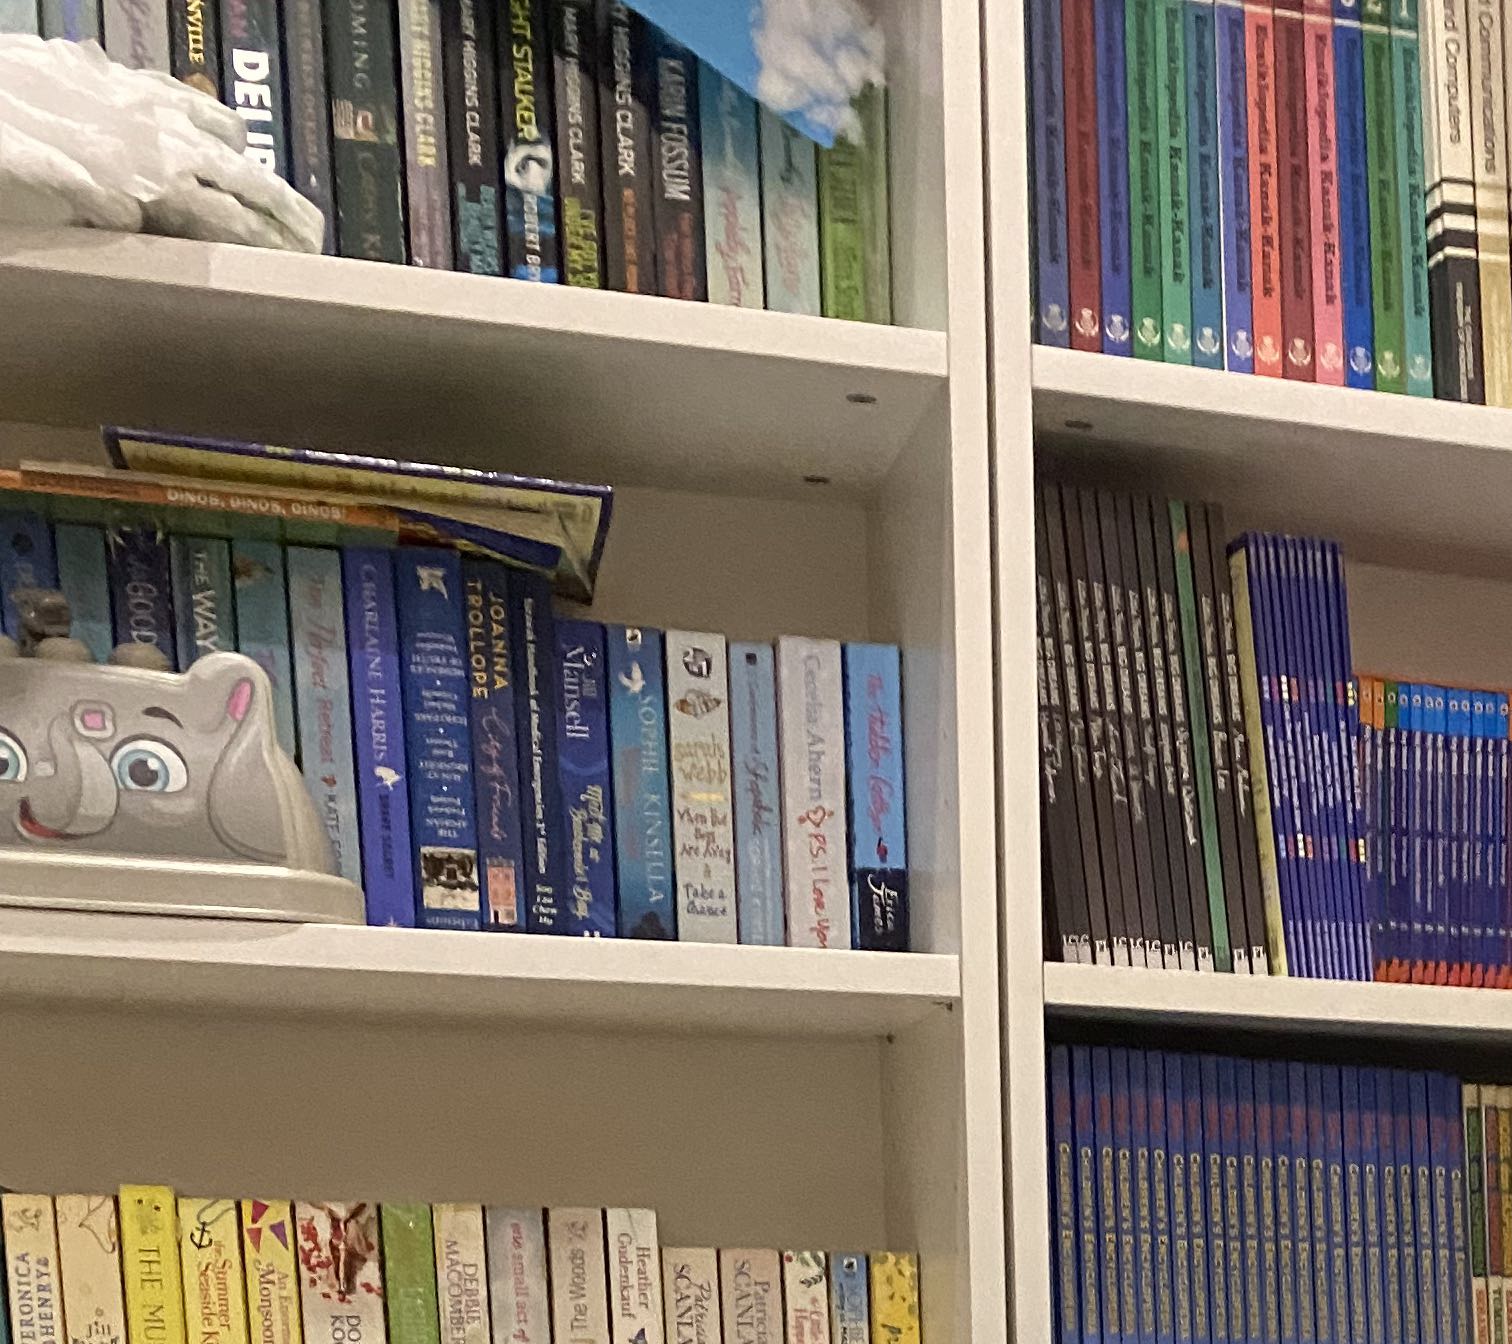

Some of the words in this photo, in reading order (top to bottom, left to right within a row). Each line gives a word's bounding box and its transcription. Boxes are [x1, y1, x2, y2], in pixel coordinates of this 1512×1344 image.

[564, 7, 579, 54] MARY
[411, 38, 434, 109] HIGGINS
[463, 40, 479, 107] HIGGINS
[512, 43, 539, 140] STALKER
[566, 57, 582, 124] HIGGINS
[612, 25, 633, 105] HIGGINS
[658, 58, 686, 117] KARIN
[1445, 39, 1462, 144] Computers
[1479, 14, 1496, 175] Communications
[416, 112, 436, 167] CLARK
[466, 112, 481, 166] CLARK
[571, 127, 585, 185] CLARK
[617, 109, 635, 176] CLARK
[660, 121, 690, 201] FOSSUM
[193, 590, 218, 652] WAY
[362, 564, 381, 680] CHARLAINE
[467, 579, 488, 699] TROLLOPE
[489, 593, 509, 690] JOANNA
[369, 688, 389, 760] HARRIS
[561, 645, 590, 740] Mansell
[806, 729, 824, 800] Ahern
[643, 792, 664, 903] KINSELLA
[813, 879, 827, 914] Love
[868, 874, 887, 935] James
[885, 889, 899, 932] Erica
[815, 919, 829, 948] You
[139, 1246, 164, 1290] THE
[198, 1262, 217, 1327] Seaside
[215, 1258, 234, 1331] Summer
[461, 1262, 481, 1325] DEBBIE
[512, 1253, 530, 1299] small
[569, 1249, 587, 1300] Woods
[616, 1232, 636, 1319] Gudenkauf
[635, 1245, 652, 1309] Heather
[38, 1266, 57, 1338] HENRY
[515, 1301, 529, 1324] act
[571, 1303, 587, 1331] The
